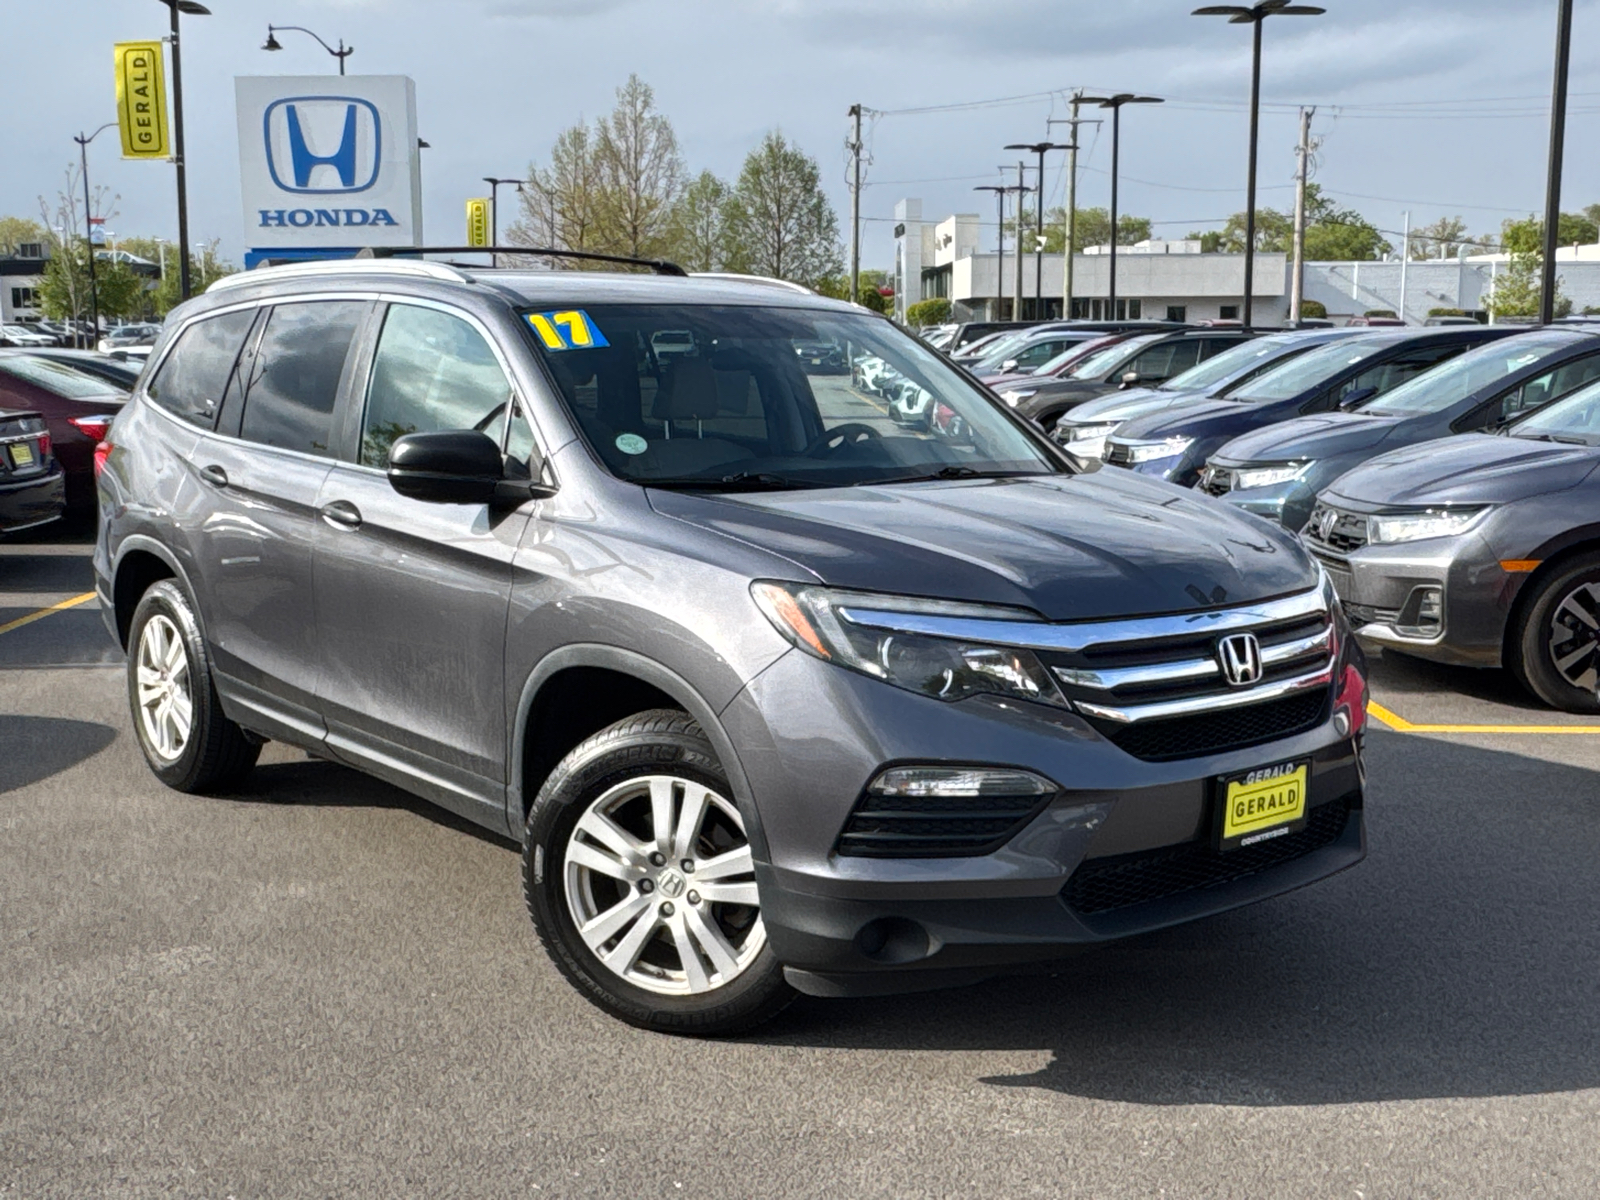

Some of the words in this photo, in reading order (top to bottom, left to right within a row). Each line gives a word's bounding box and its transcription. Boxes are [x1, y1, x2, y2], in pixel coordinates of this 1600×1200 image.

[132, 57, 153, 144] GERALD
[258, 208, 399, 227] HONDA
[474, 205, 483, 245] GERALD
[528, 310, 593, 349] 17
[1246, 762, 1294, 785] GERALD
[1235, 789, 1296, 818] GERALD
